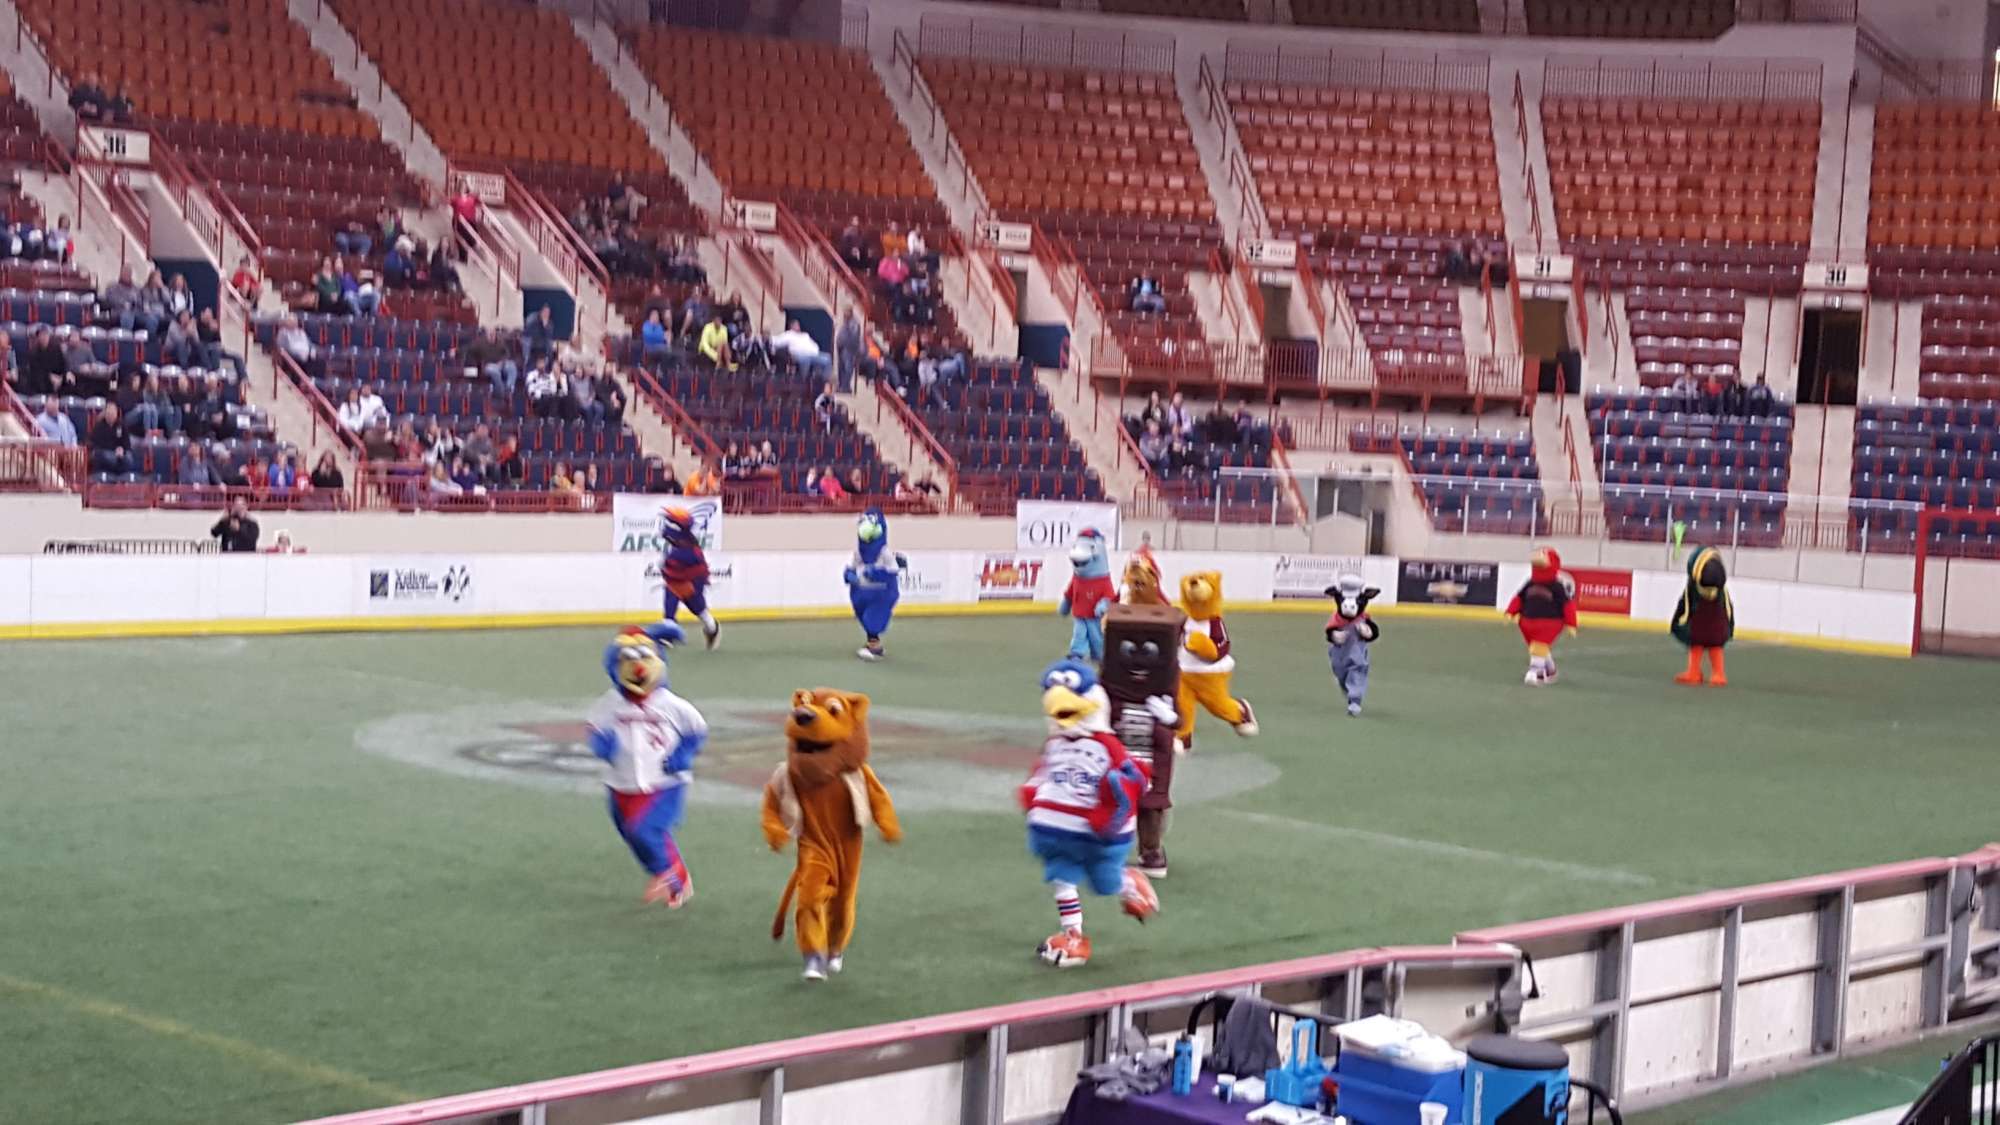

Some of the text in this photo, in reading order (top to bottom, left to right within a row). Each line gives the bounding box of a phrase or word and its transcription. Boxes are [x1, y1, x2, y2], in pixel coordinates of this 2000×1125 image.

[1535, 256, 1551, 278] 31
[1825, 265, 1847, 288] 30
[621, 533, 714, 553] AFSE
[1028, 519, 1071, 549] OIP
[980, 558, 1043, 589] HEAT
[1406, 562, 1491, 580] SUTLIFF
